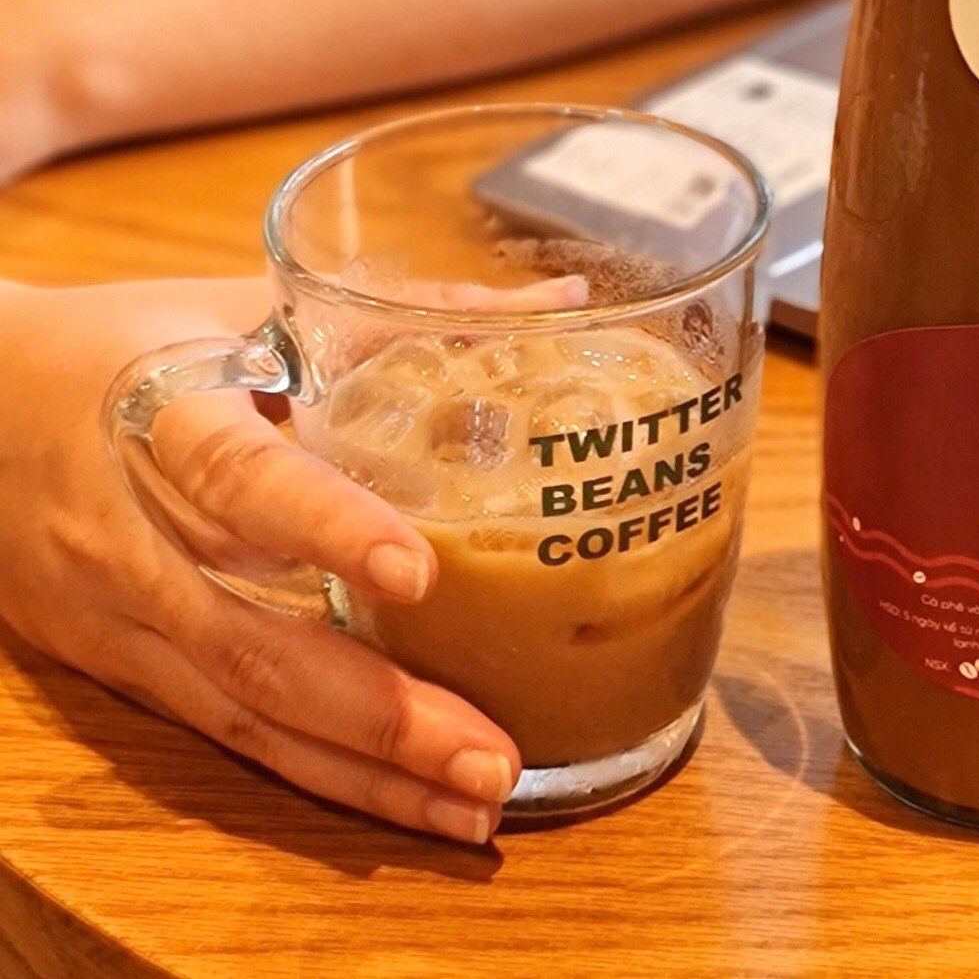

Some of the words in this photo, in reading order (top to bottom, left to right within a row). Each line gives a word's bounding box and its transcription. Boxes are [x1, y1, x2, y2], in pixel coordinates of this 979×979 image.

[529, 372, 743, 467] TWITTER
[541, 442, 711, 517] BEANS
[537, 481, 722, 566] COFFEE
